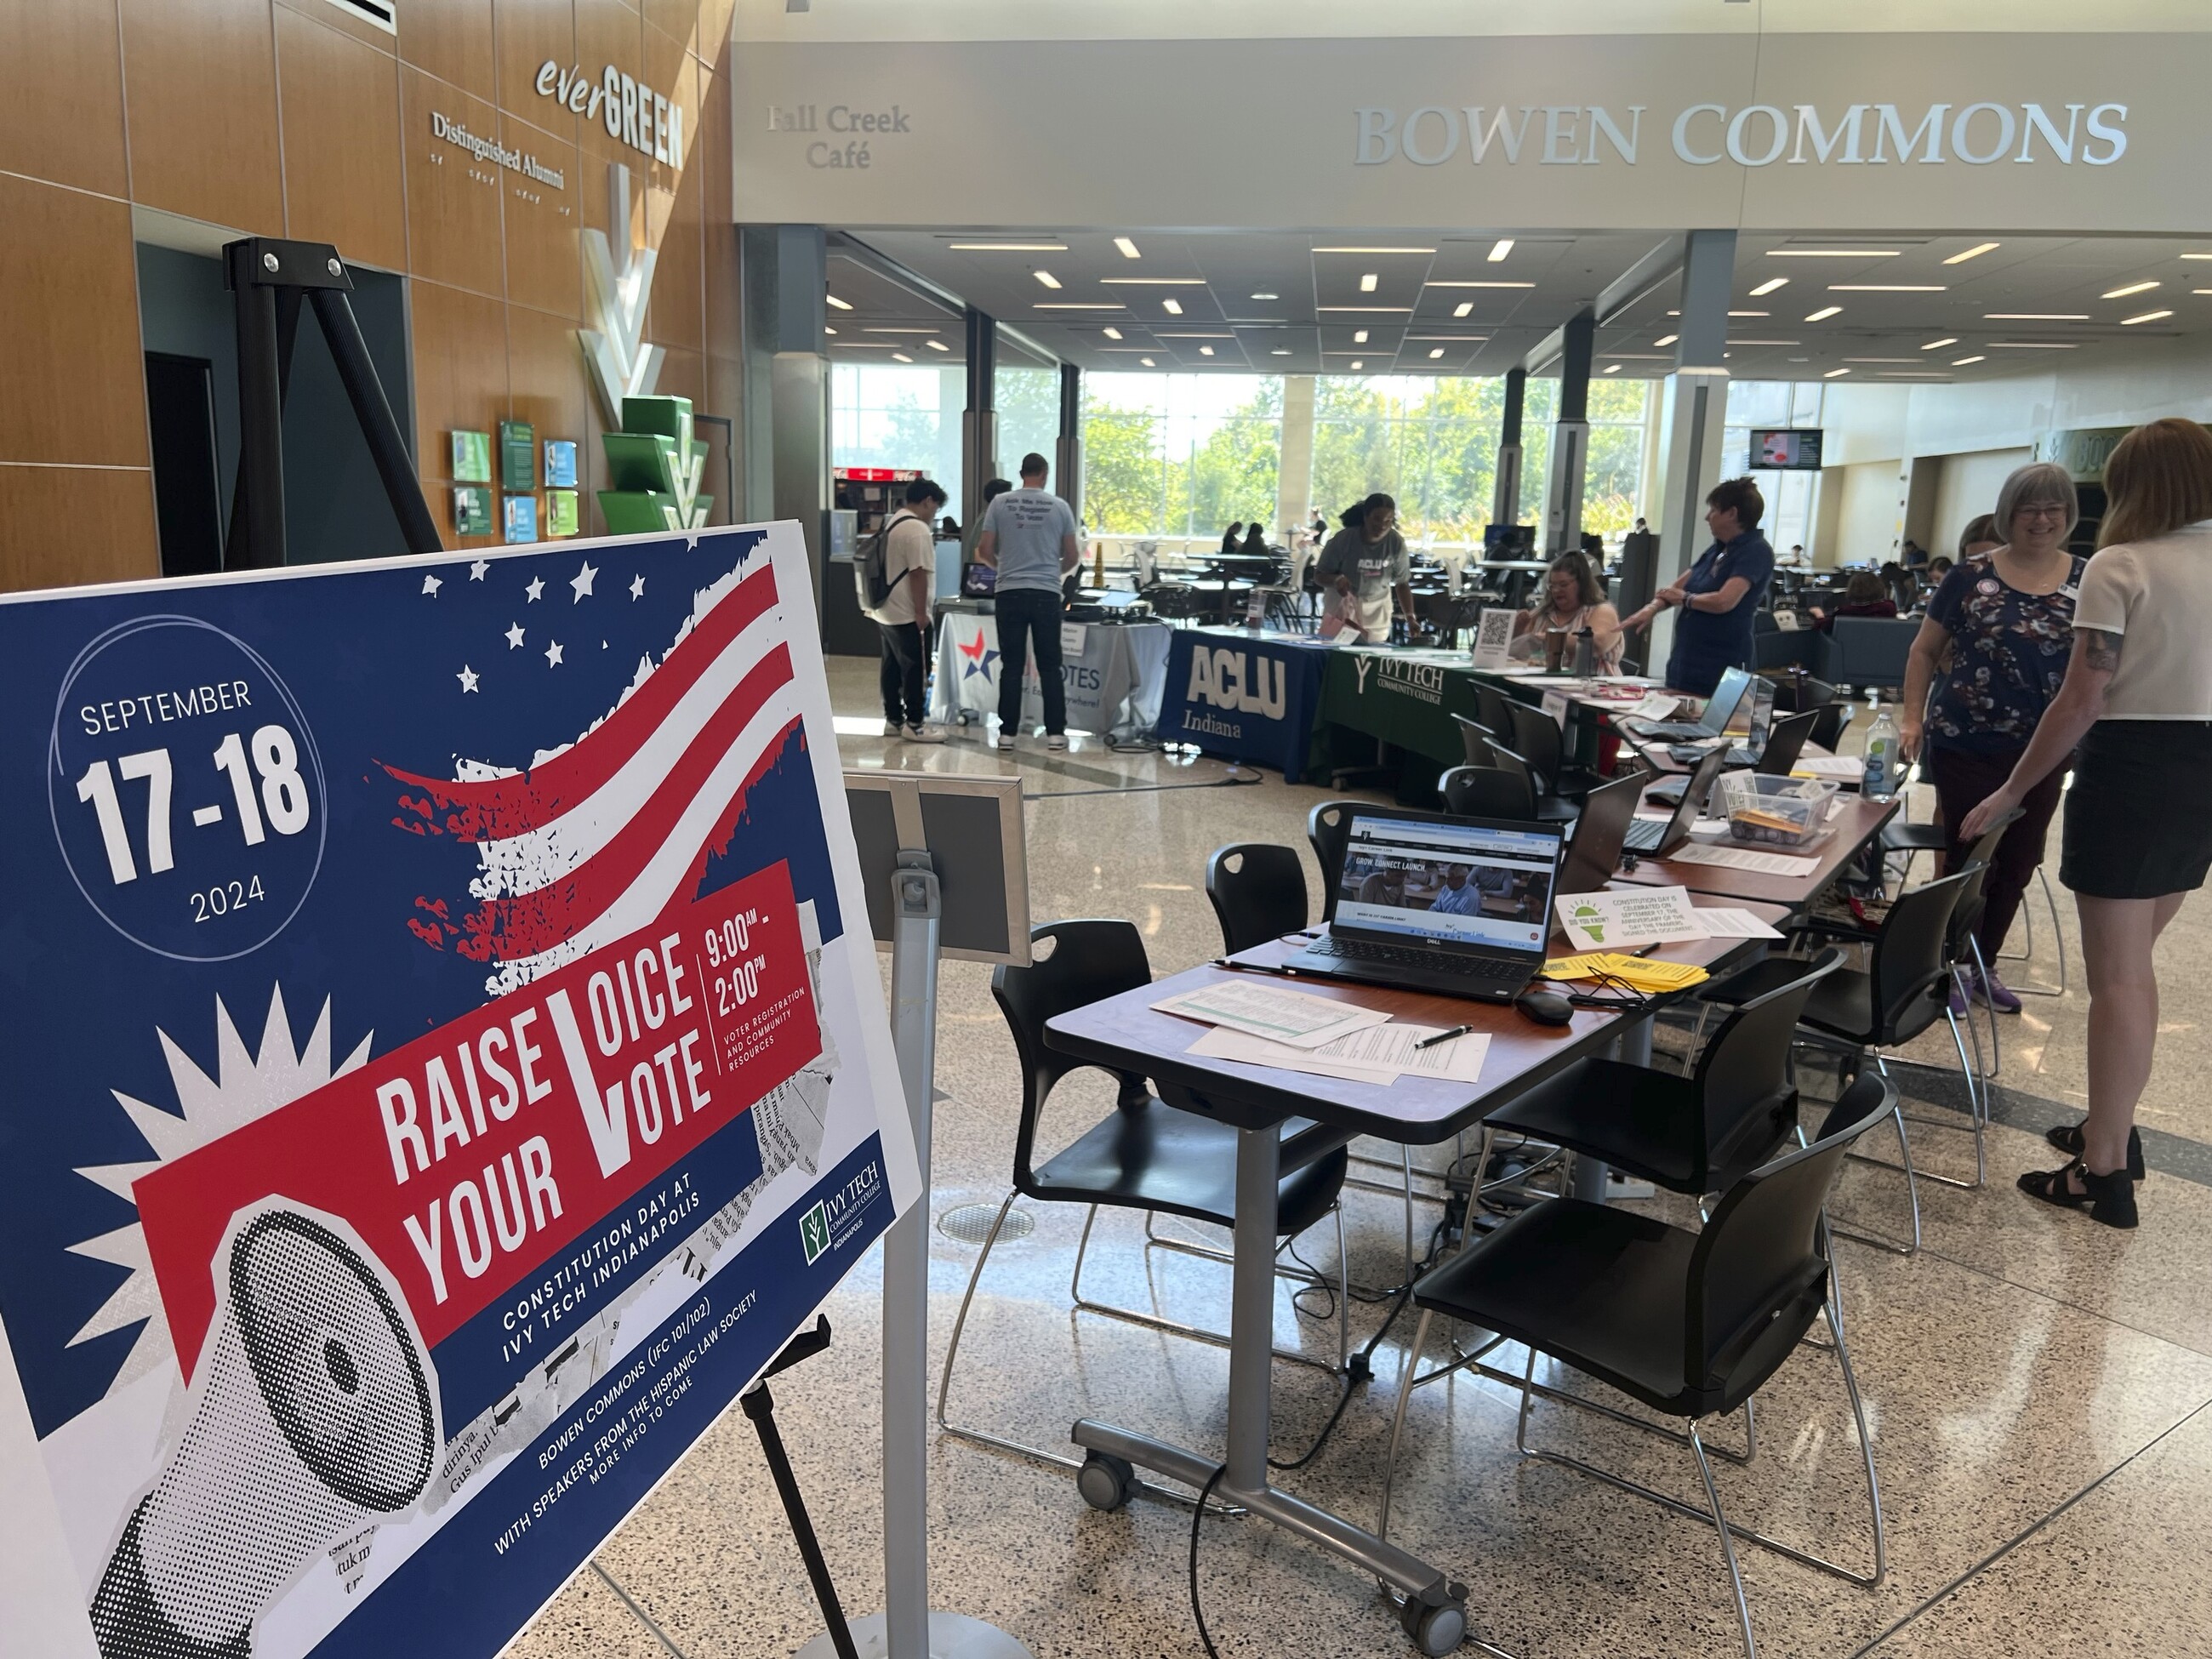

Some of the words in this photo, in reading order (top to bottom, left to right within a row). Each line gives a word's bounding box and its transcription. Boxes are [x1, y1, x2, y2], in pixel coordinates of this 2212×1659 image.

[767, 105, 818, 133] Fall
[826, 105, 911, 133] Creek
[1354, 105, 1647, 166] BOWEN
[1671, 104, 2129, 167] COMMONS
[432, 111, 522, 171] Distinguished
[522, 153, 564, 191] Alumni
[807, 140, 871, 169] Café
[1187, 645, 1286, 721] ACLU
[1377, 678, 1413, 697] COMMUNITY
[1414, 689, 1440, 705] COLLEGE
[1379, 656, 1403, 678] IVY
[1406, 662, 1444, 690] TECH
[81, 681, 252, 735] SEPTEMBER
[1182, 710, 1242, 738] Indiana
[190, 875, 265, 922] 2024
[1612, 897, 1656, 906] CONSTITUTION
[1657, 896, 1670, 904] DAY
[1621, 916, 1662, 925] ANNIVERSARY
[724, 1022, 750, 1045] VOTER
[753, 986, 805, 1026] REGISTRATION
[727, 1042, 744, 1059] AND
[746, 1009, 792, 1046] COMMUNITY
[728, 1035, 775, 1072] RESOURCES
[376, 1006, 553, 1185] RAISE
[825, 1189, 846, 1223] IVY
[847, 1160, 878, 1201] TECH
[830, 1199, 861, 1233] COMMUNITY
[861, 1180, 881, 1204] COLLEGE
[402, 1135, 563, 1306] YOUR
[834, 1218, 864, 1251] INDIANAPOLIS
[503, 1219, 632, 1331] CONSTITUTION
[638, 1190, 666, 1225] DAY
[675, 1172, 690, 1198] AT
[503, 1324, 533, 1362] IVY
[541, 1282, 586, 1329] TECH
[592, 1191, 699, 1288] INDIANAPOLIS
[539, 1417, 584, 1469] BOWEN
[585, 1361, 646, 1424] COMMONS
[648, 1338, 670, 1367] (IFC
[671, 1296, 710, 1344] 101/102)
[494, 1512, 532, 1555] WITH
[533, 1451, 594, 1519] SPEAKERS
[594, 1419, 628, 1458] FROM
[628, 1400, 650, 1427] THE
[650, 1349, 697, 1403] HISPANIC
[698, 1331, 719, 1355] LAW
[721, 1290, 757, 1333] SOCIETY
[589, 1452, 620, 1485] MORE
[623, 1422, 647, 1452] INFO
[649, 1406, 663, 1424] TO
[665, 1375, 693, 1405] COME
[442, 1432, 478, 1479] dirinya.
[450, 1465, 471, 1493] Gus
